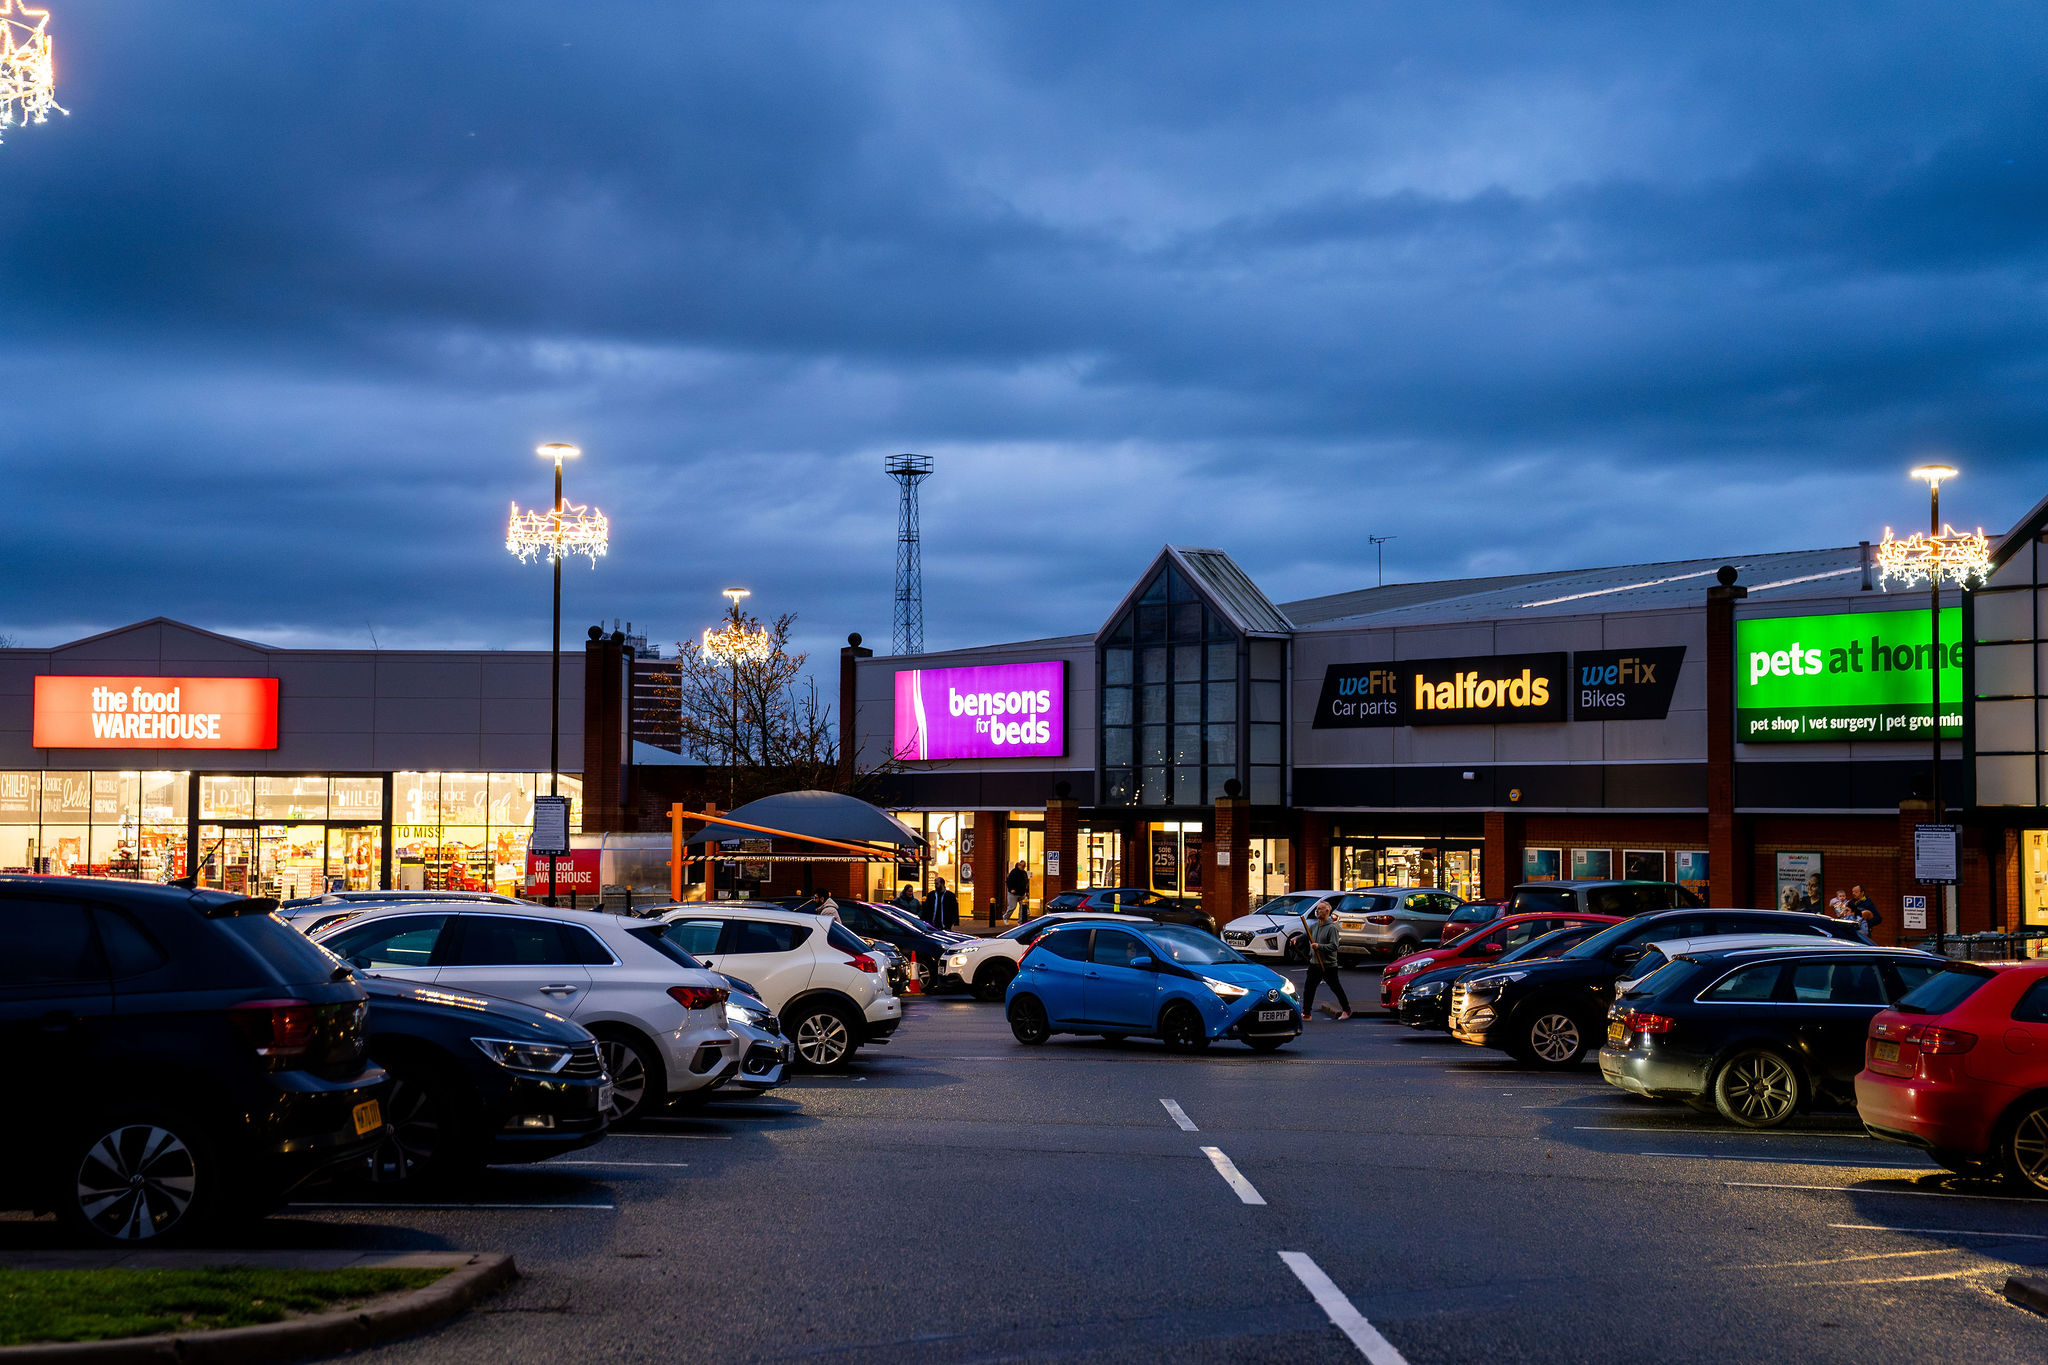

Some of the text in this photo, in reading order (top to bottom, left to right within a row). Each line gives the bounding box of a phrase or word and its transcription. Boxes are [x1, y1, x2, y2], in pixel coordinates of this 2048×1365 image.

[1581, 657, 1657, 686] weFix
[1750, 636, 1963, 686] pets at home
[1338, 670, 1397, 696] weFit
[1415, 668, 1550, 710] halfords
[91, 686, 180, 712] the food
[949, 687, 1051, 717] bensons
[1332, 699, 1397, 719] Car parts
[1581, 689, 1626, 708] Bikes
[91, 713, 221, 739] WAREHOUSE
[975, 713, 1051, 745] for beds
[1750, 715, 1799, 734] pet shop
[1809, 715, 1877, 732] vet surgery
[1886, 715, 1907, 732] pet
[1, 774, 29, 798] CHILLED
[396, 826, 410, 838] TO
[535, 860, 574, 871] the ood
[534, 871, 592, 883] WAEHOUSE
[1906, 897, 1913, 907] P
